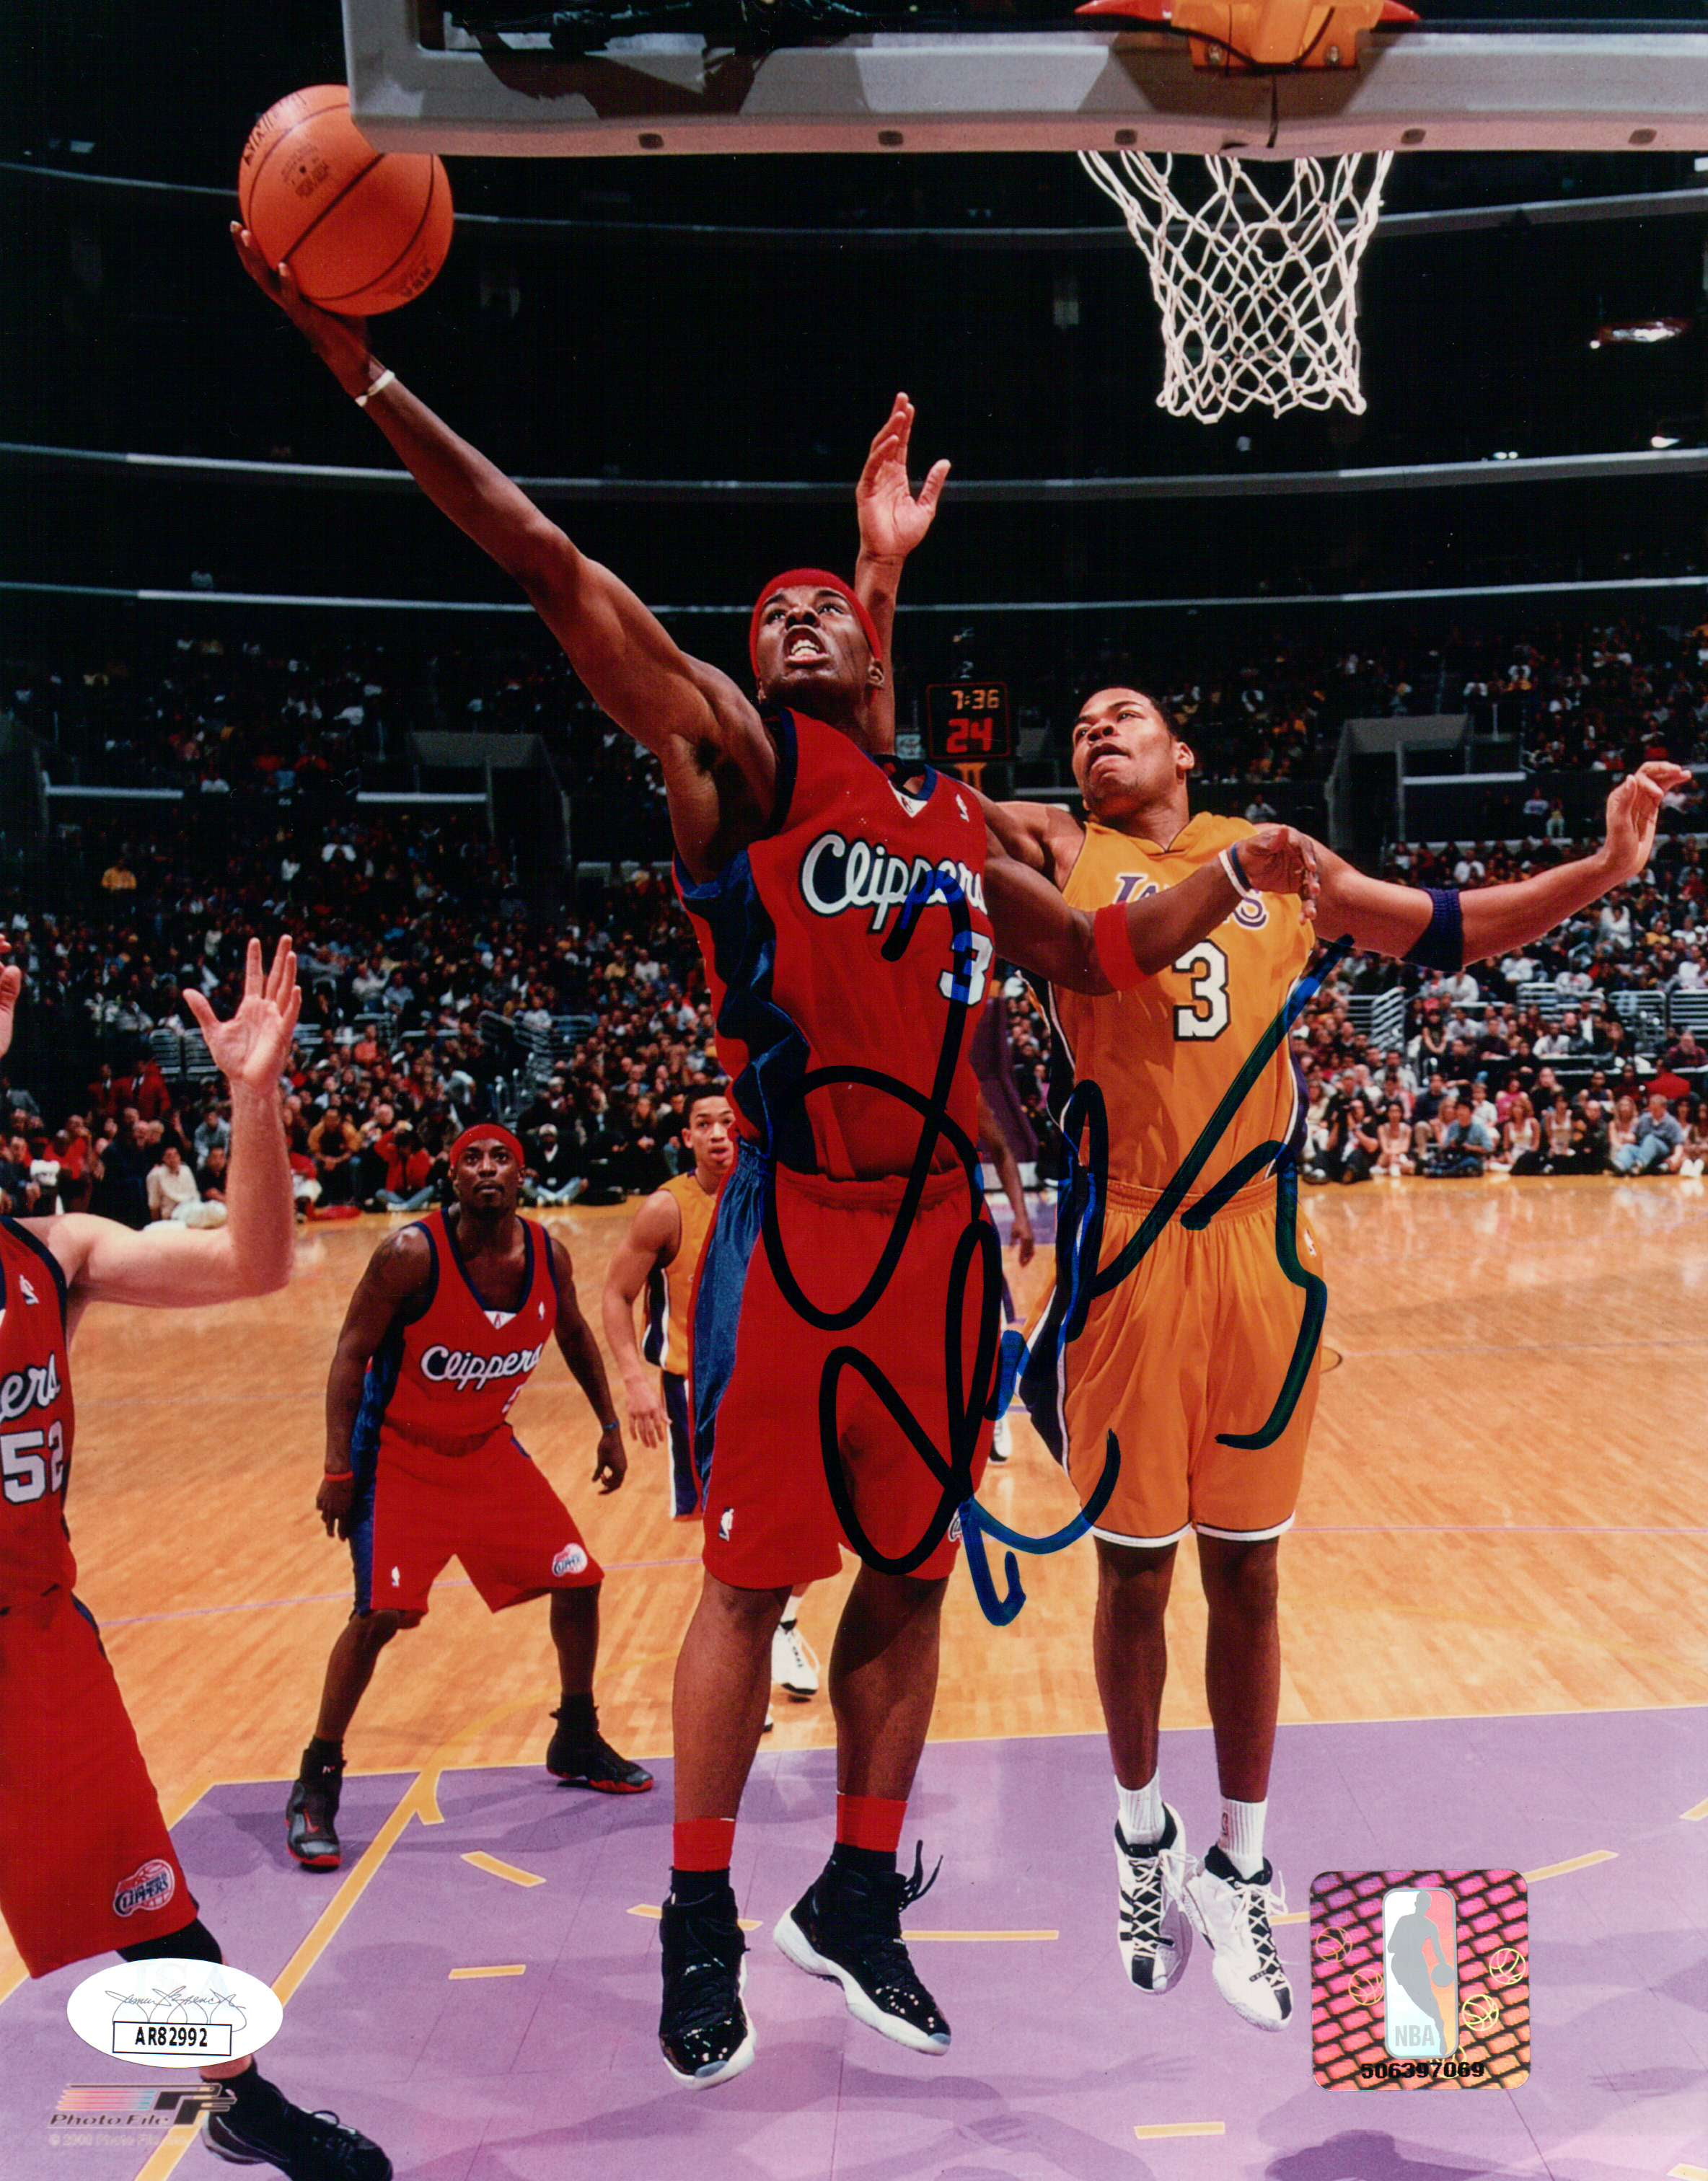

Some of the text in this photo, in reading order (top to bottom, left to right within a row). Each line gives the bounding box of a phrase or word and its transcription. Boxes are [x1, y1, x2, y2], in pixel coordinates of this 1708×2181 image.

[951, 689, 1000, 710] 7:36
[946, 718, 993, 754] 24
[937, 929, 994, 1006] 3
[1172, 938, 1231, 1041] 3
[420, 1342, 544, 1391] Clippers
[135, 2026, 208, 2048] AR82992
[1394, 2024, 1435, 2047] NBA
[1360, 2061, 1484, 2079] 506397069
